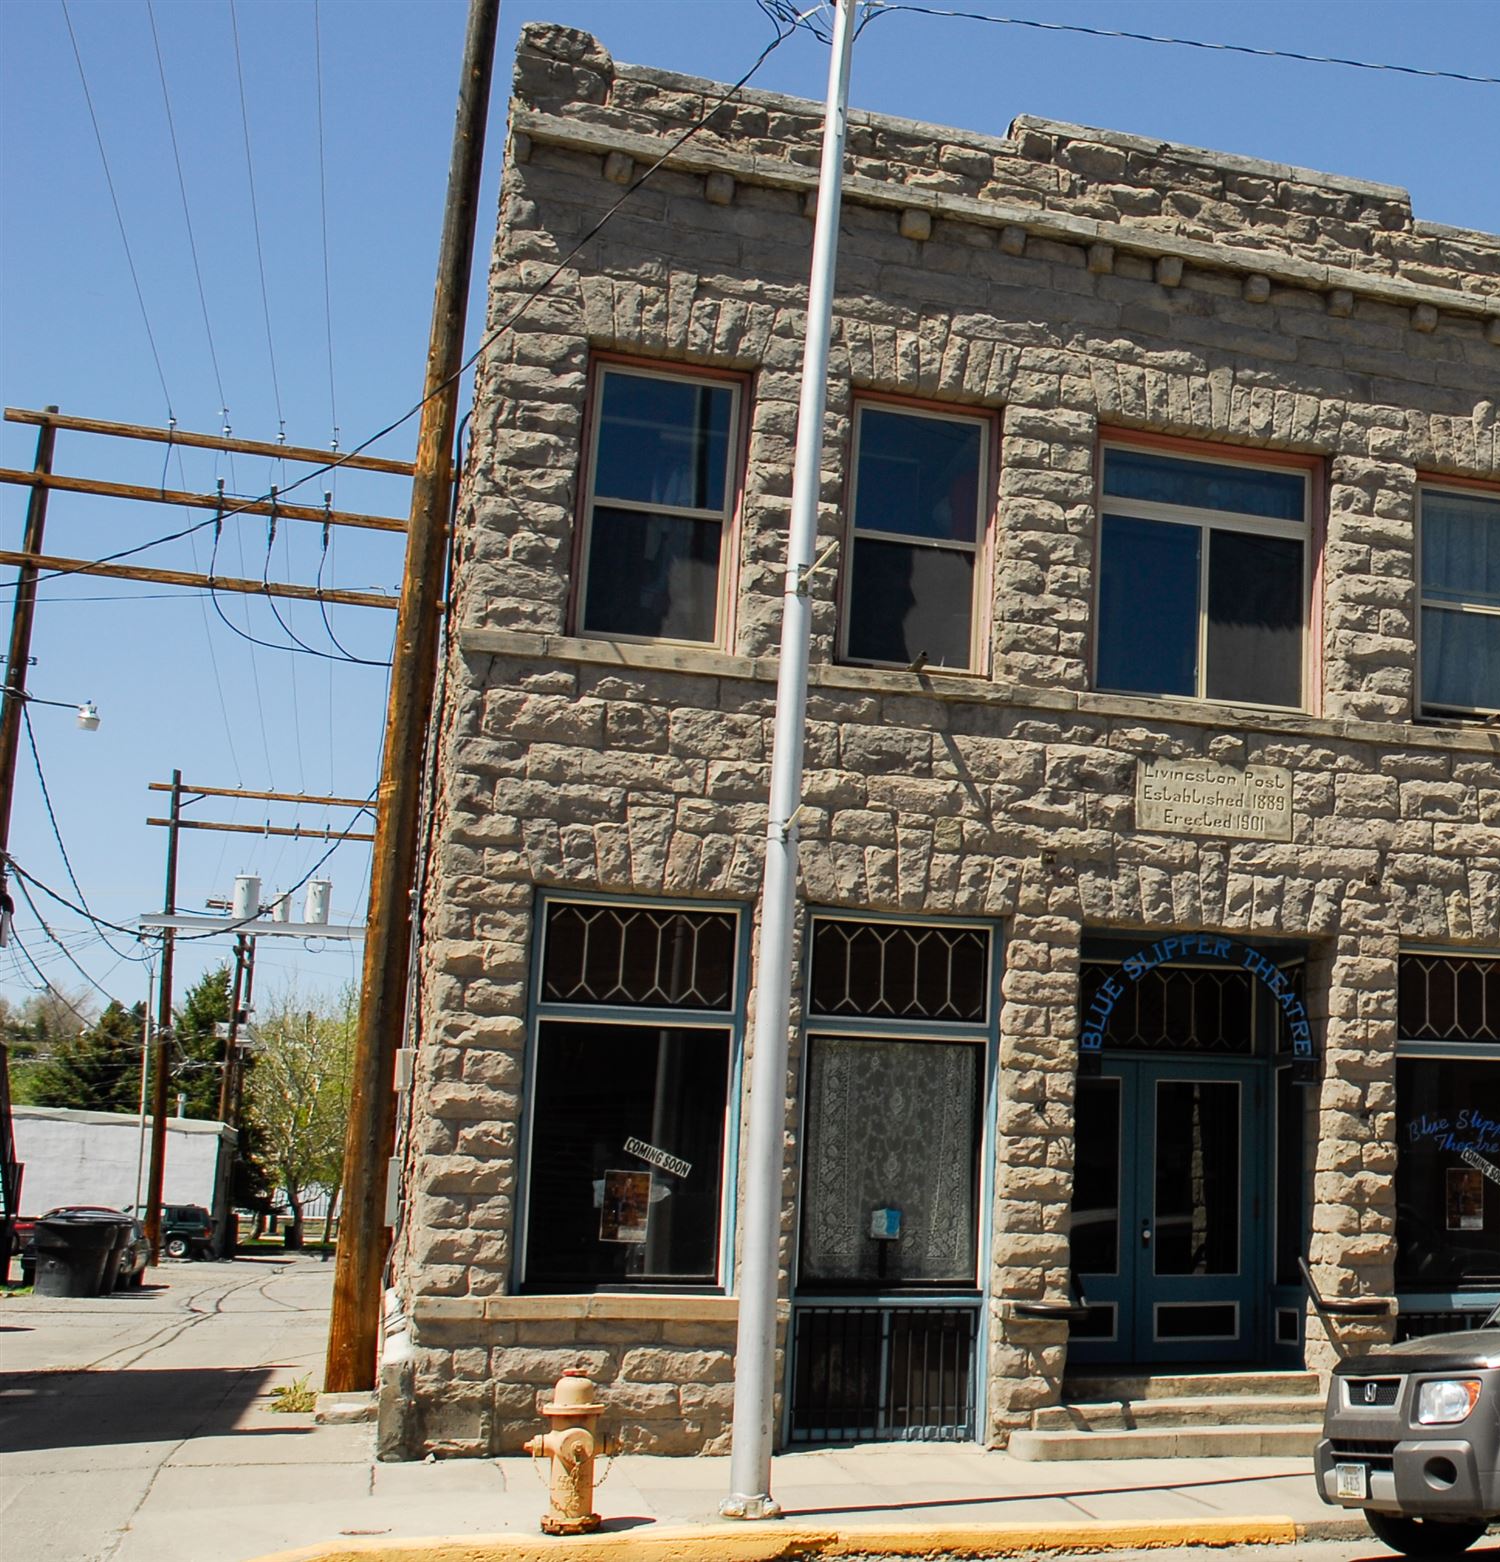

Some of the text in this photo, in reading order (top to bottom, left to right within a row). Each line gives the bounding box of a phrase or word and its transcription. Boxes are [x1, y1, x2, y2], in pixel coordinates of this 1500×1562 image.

[1244, 771, 1286, 789] Post
[1143, 785, 1285, 812] Established 1889
[1163, 808, 1265, 832] Erected 1901
[1082, 934, 1312, 1056] BLUE SLIPPER THEATRE
[1409, 1115, 1449, 1141] Blue
[626, 1139, 690, 1176] COMING SOON
[1462, 1150, 1491, 1174] COMING
